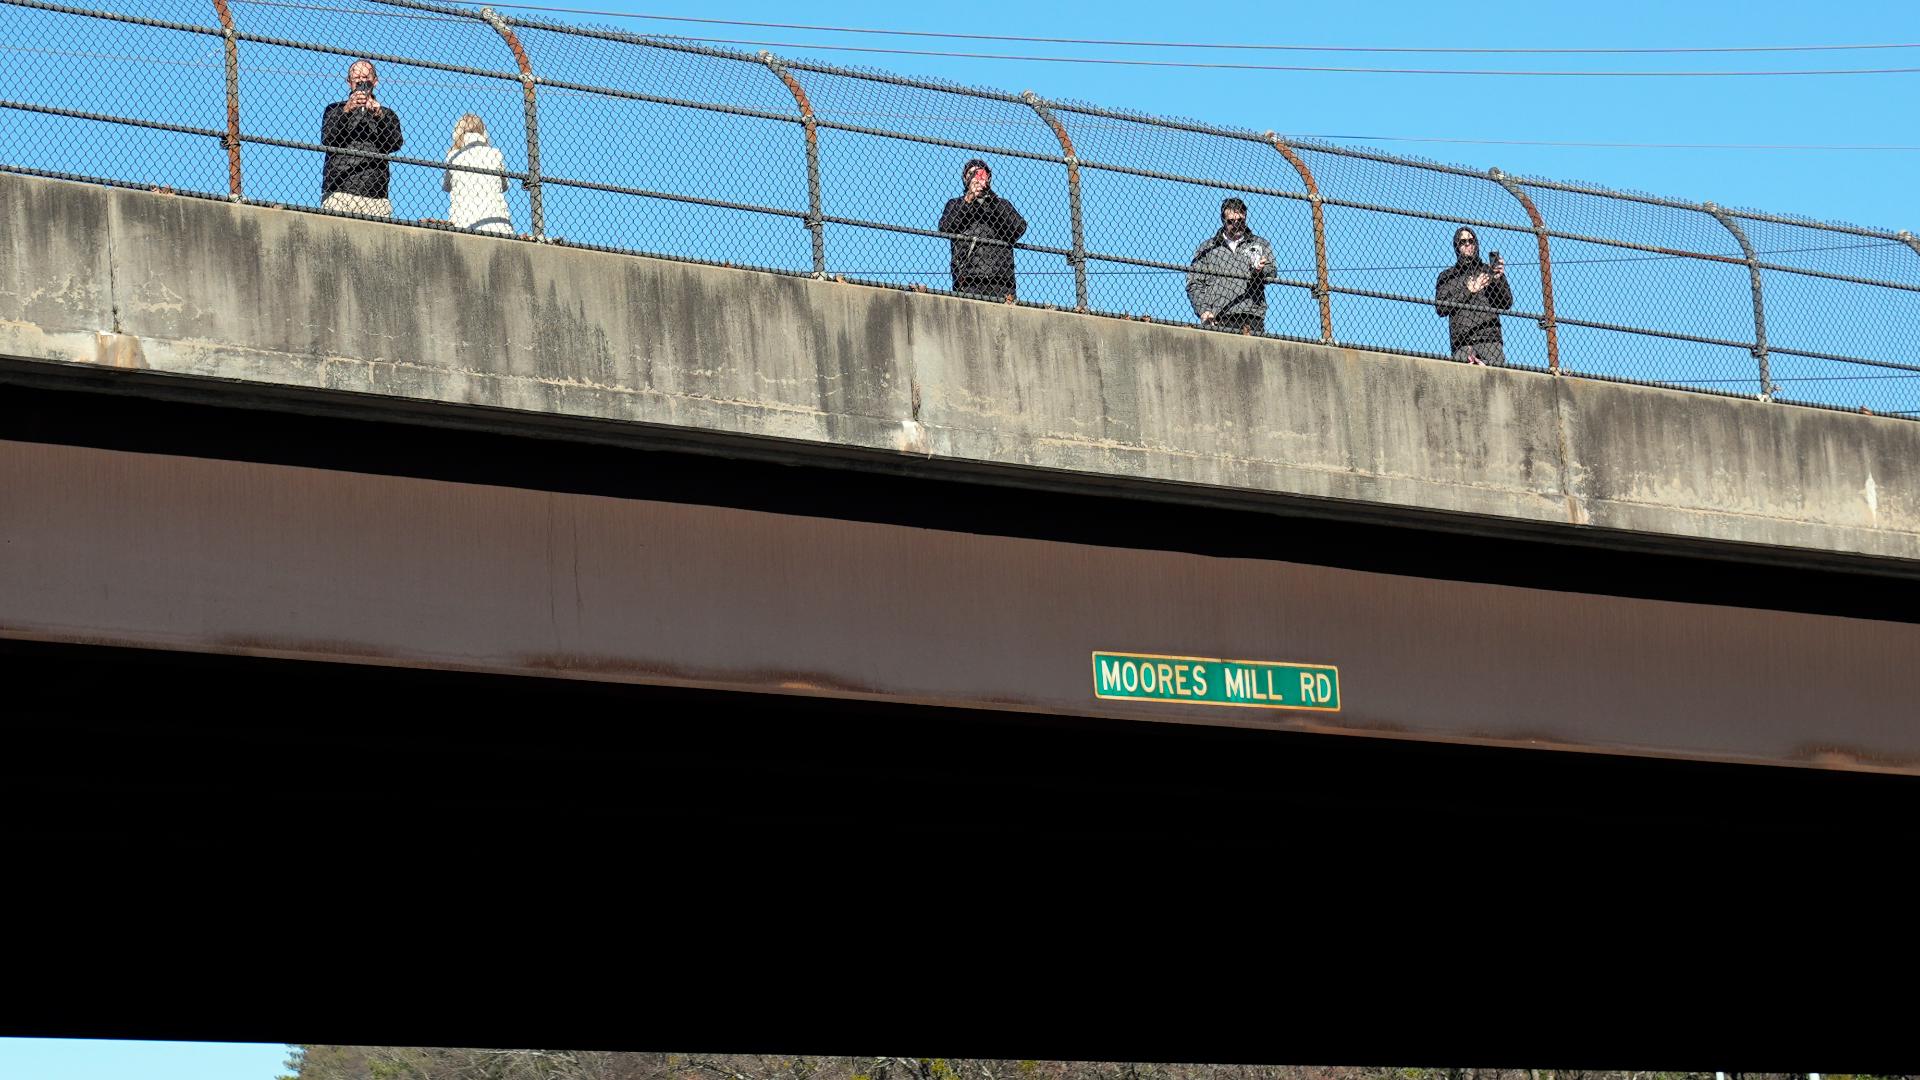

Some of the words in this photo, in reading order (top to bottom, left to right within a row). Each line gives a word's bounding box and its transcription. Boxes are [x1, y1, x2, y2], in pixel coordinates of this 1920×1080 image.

[1101, 660, 1208, 696] MOORES
[1224, 667, 1283, 701] MILL
[1300, 672, 1332, 703] RD
